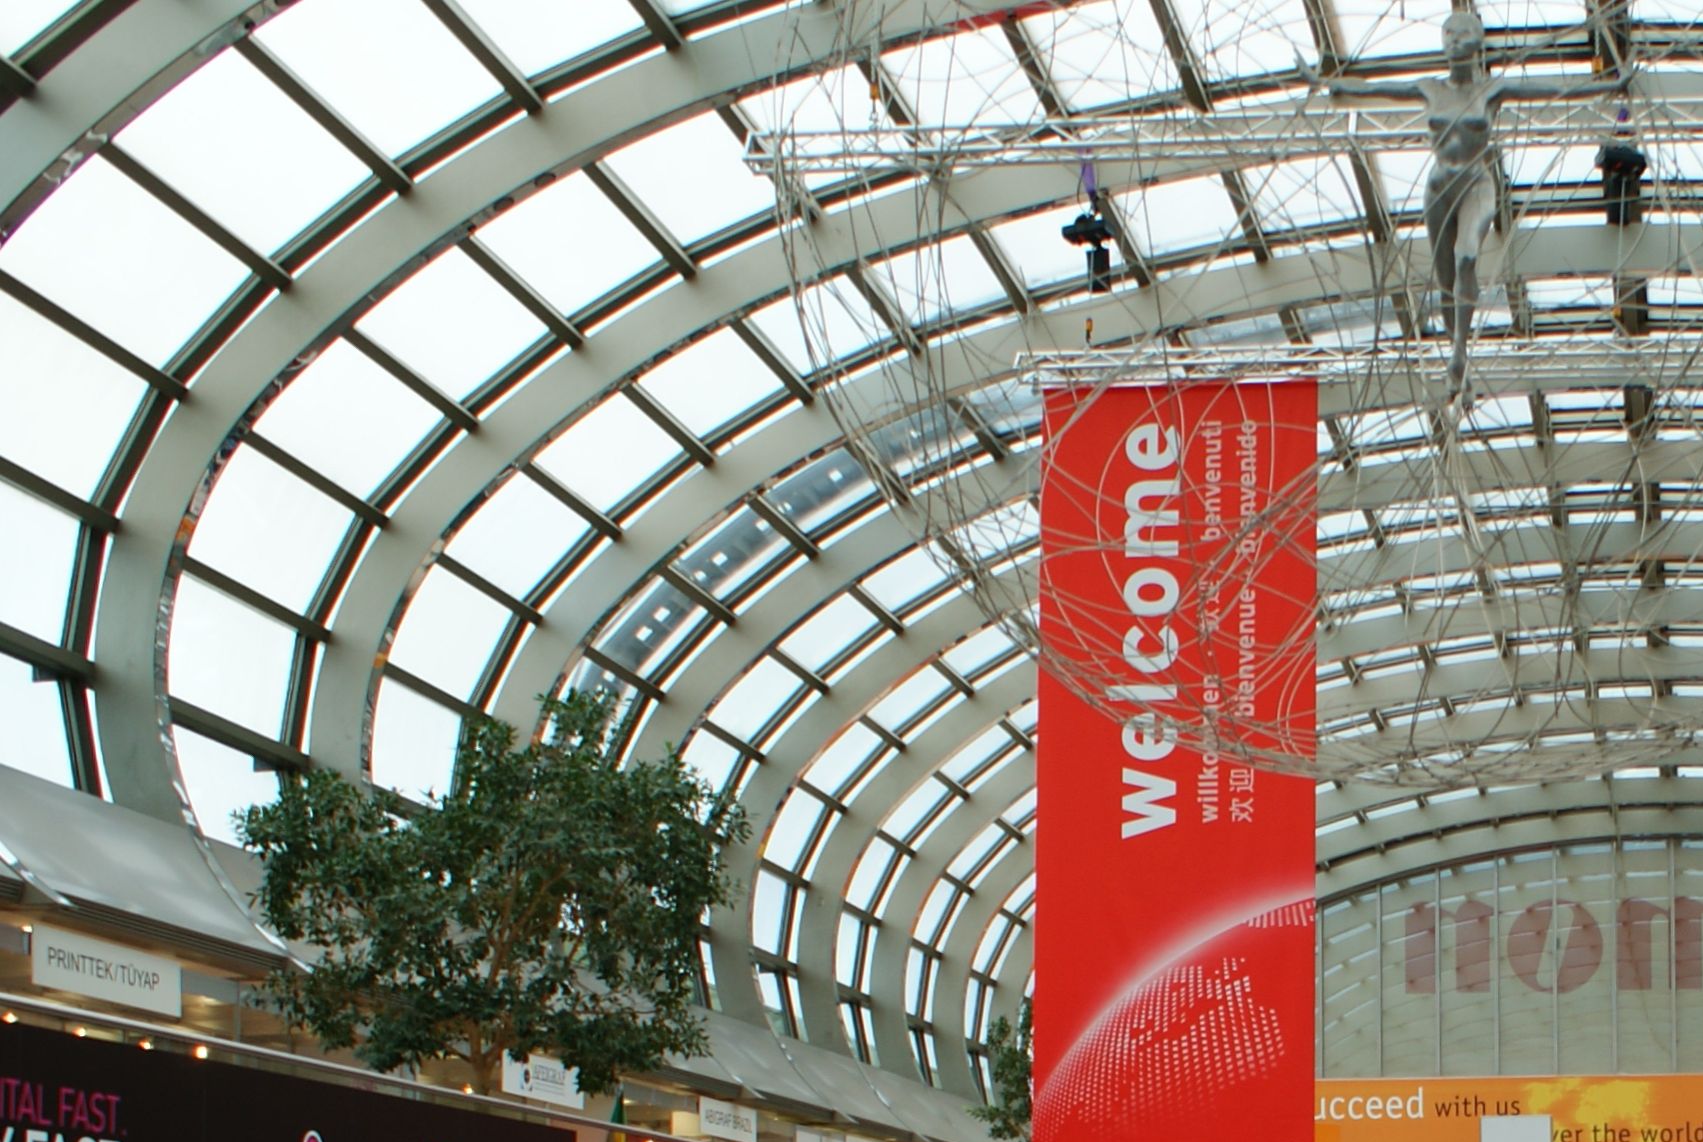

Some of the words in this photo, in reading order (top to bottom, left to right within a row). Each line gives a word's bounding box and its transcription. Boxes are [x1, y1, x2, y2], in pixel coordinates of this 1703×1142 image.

[1201, 419, 1222, 542] benvenuti
[1235, 419, 1258, 554] bnvenido
[1106, 422, 1181, 839] welcome
[1233, 590, 1256, 718] bienvenue
[1197, 674, 1219, 823] willkoen
[58, 1086, 127, 1136] FAST.
[1314, 1087, 1424, 1120] ucceed
[1435, 1096, 1487, 1118] with
[1496, 1100, 1521, 1116] us
